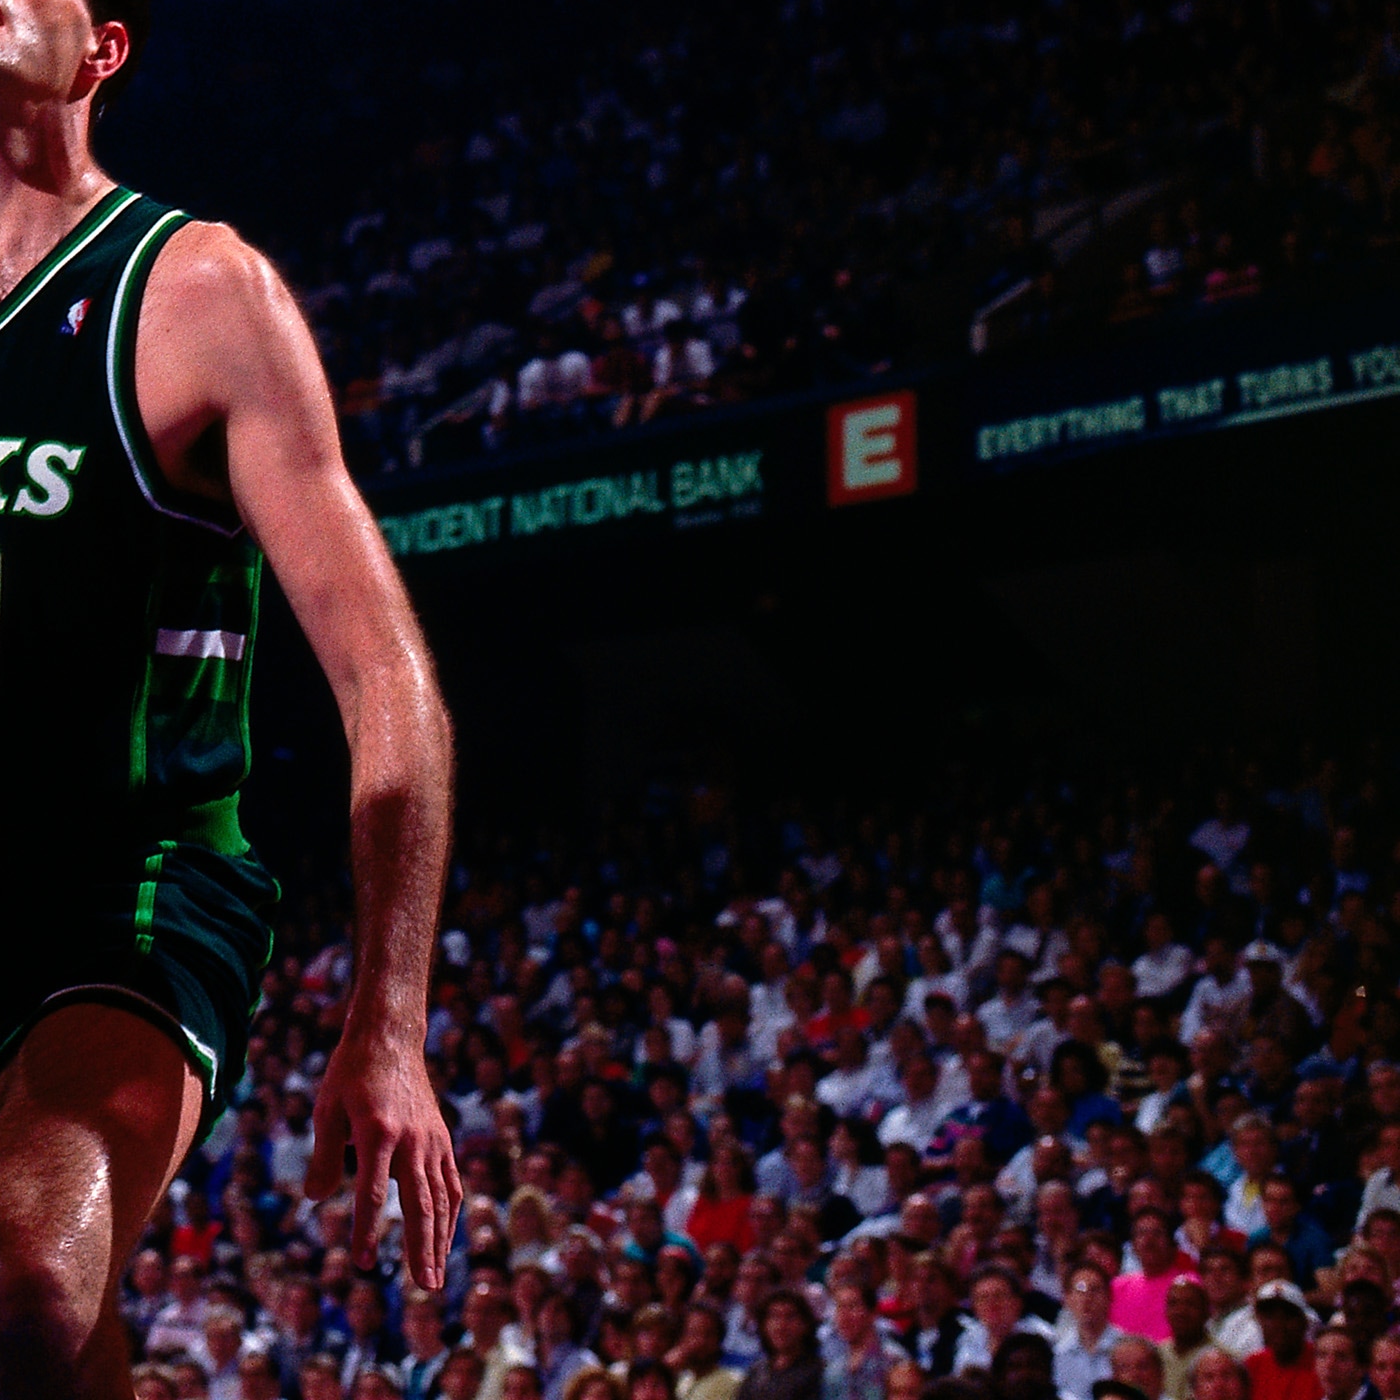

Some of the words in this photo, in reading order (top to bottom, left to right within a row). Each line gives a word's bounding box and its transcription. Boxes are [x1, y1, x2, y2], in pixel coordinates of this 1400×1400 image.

[1156, 377, 1226, 424] THAT
[841, 403, 903, 492] E
[509, 470, 666, 537] NATIONAL
[669, 448, 765, 510] BANK
